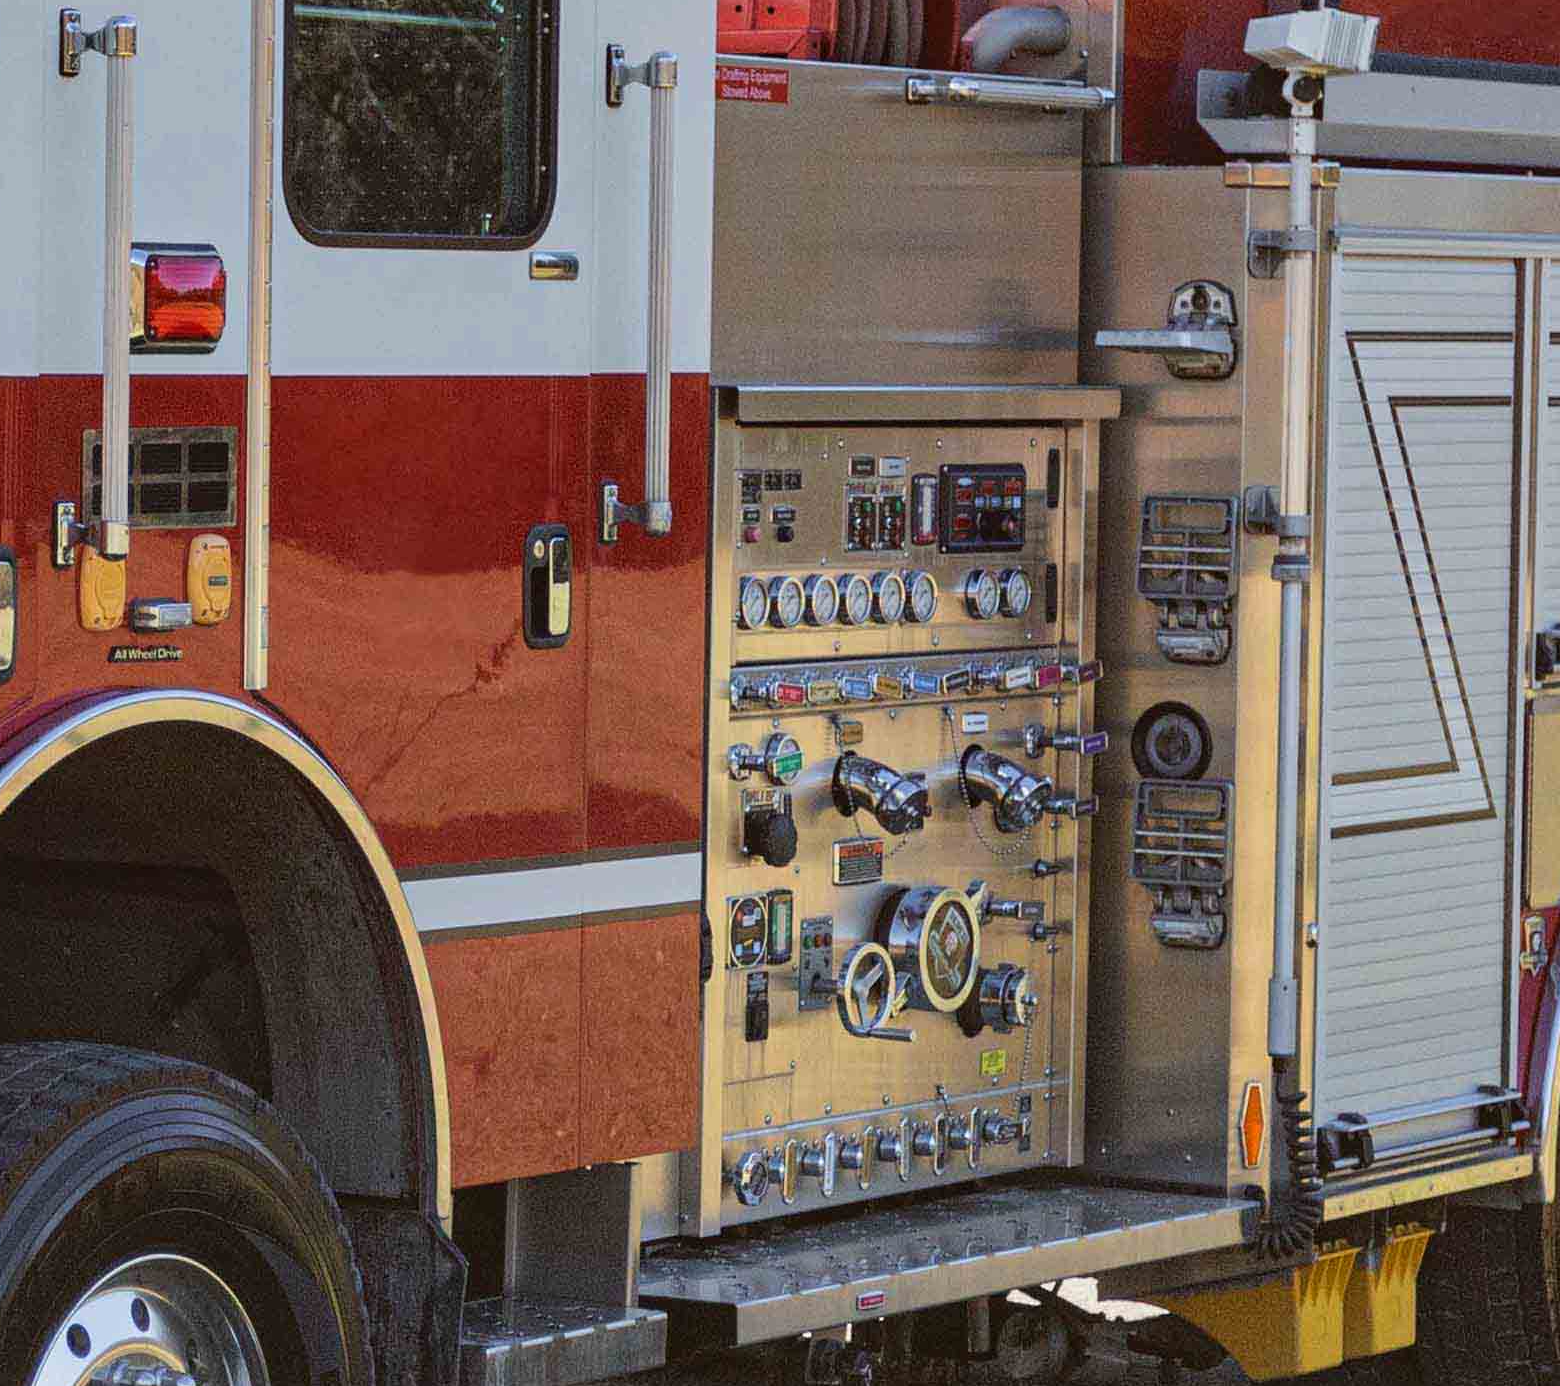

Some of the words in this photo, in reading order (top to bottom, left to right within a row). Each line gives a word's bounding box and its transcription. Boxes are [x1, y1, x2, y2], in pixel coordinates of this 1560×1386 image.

[750, 69, 787, 85] Equipment
[721, 84, 749, 99] Stowed
[749, 86, 771, 100] Above
[113, 648, 127, 661] All
[128, 647, 157, 660] Wheel
[158, 647, 184, 661] Drive
